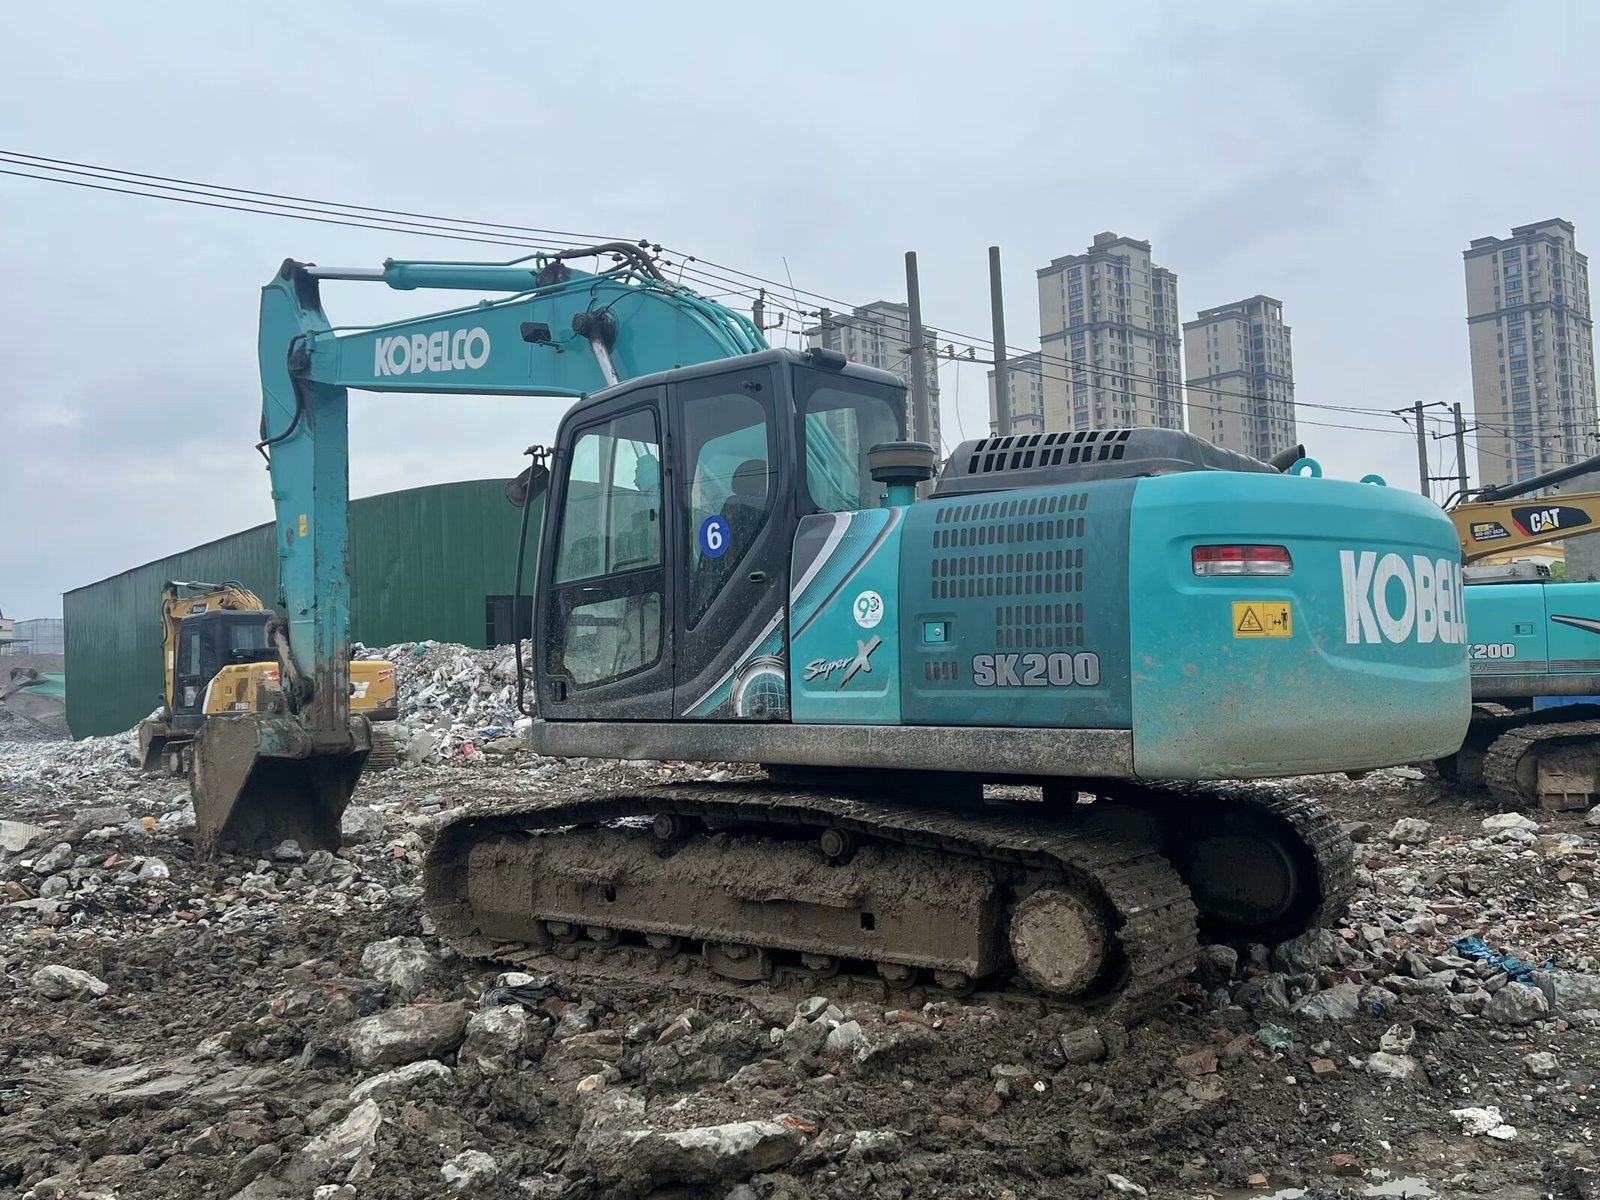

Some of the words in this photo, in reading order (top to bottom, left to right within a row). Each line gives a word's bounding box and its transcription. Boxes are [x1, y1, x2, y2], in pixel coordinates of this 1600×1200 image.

[374, 326, 491, 377] KOBELCO
[706, 521, 723, 550] 6
[1529, 508, 1560, 532] CAT
[803, 655, 854, 682] Super
[840, 634, 883, 688] X
[972, 652, 1101, 688] SK200
